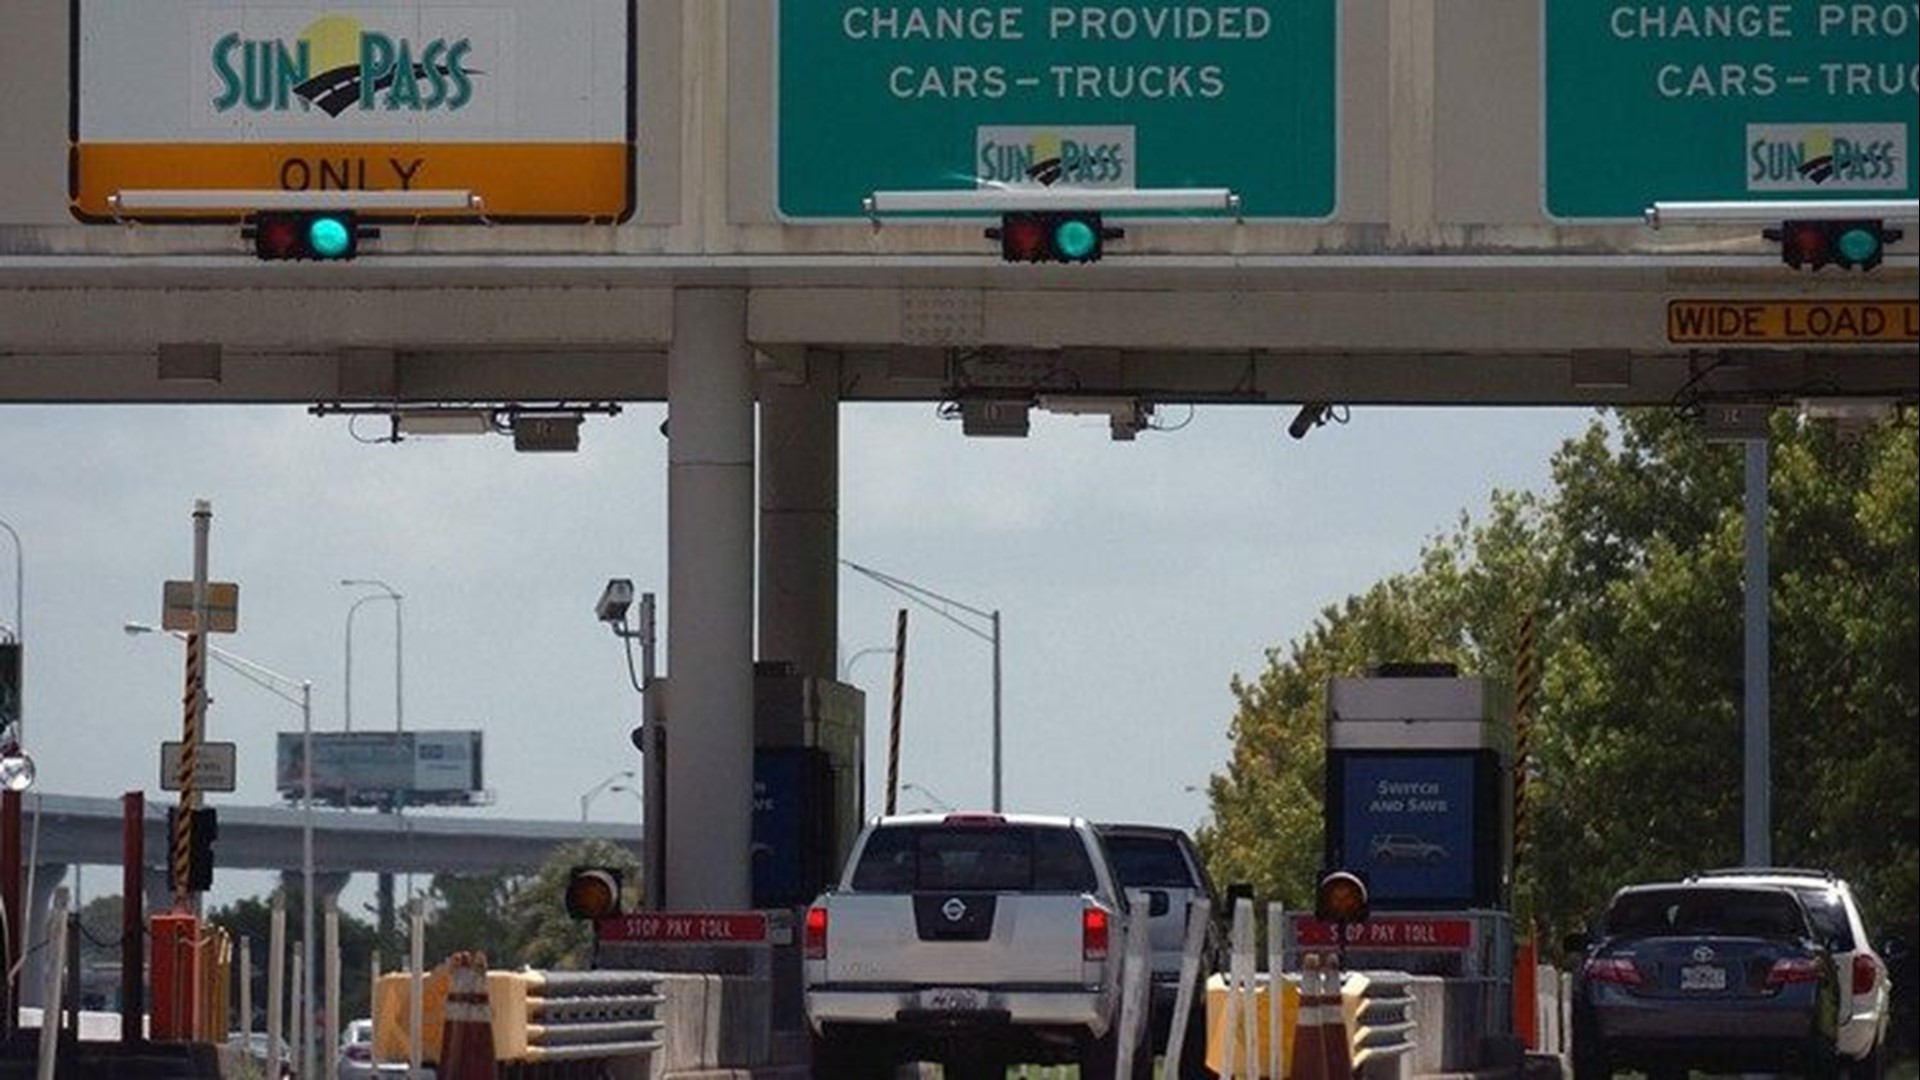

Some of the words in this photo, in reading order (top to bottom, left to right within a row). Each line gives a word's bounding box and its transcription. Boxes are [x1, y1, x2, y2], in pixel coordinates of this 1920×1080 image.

[843, 6, 1024, 40] CHANGE
[1050, 6, 1271, 39] PROVIDED
[1610, 4, 1792, 39] CHANGE
[1819, 4, 1920, 37] PRO
[211, 30, 311, 114] SUN
[357, 29, 473, 112] PASS
[279, 157, 425, 191] ONLY
[1674, 306, 1768, 337] WIDE
[1783, 306, 1887, 337] LOAD
[1369, 799, 1404, 813] AND
[1406, 797, 1448, 813] SAVE
[626, 918, 660, 938] STOP
[666, 918, 693, 938] PAY
[700, 918, 734, 938] TOLL
[1329, 923, 1366, 942] SOP
[1370, 923, 1397, 942] PAY
[1404, 923, 1438, 942] TOLL
